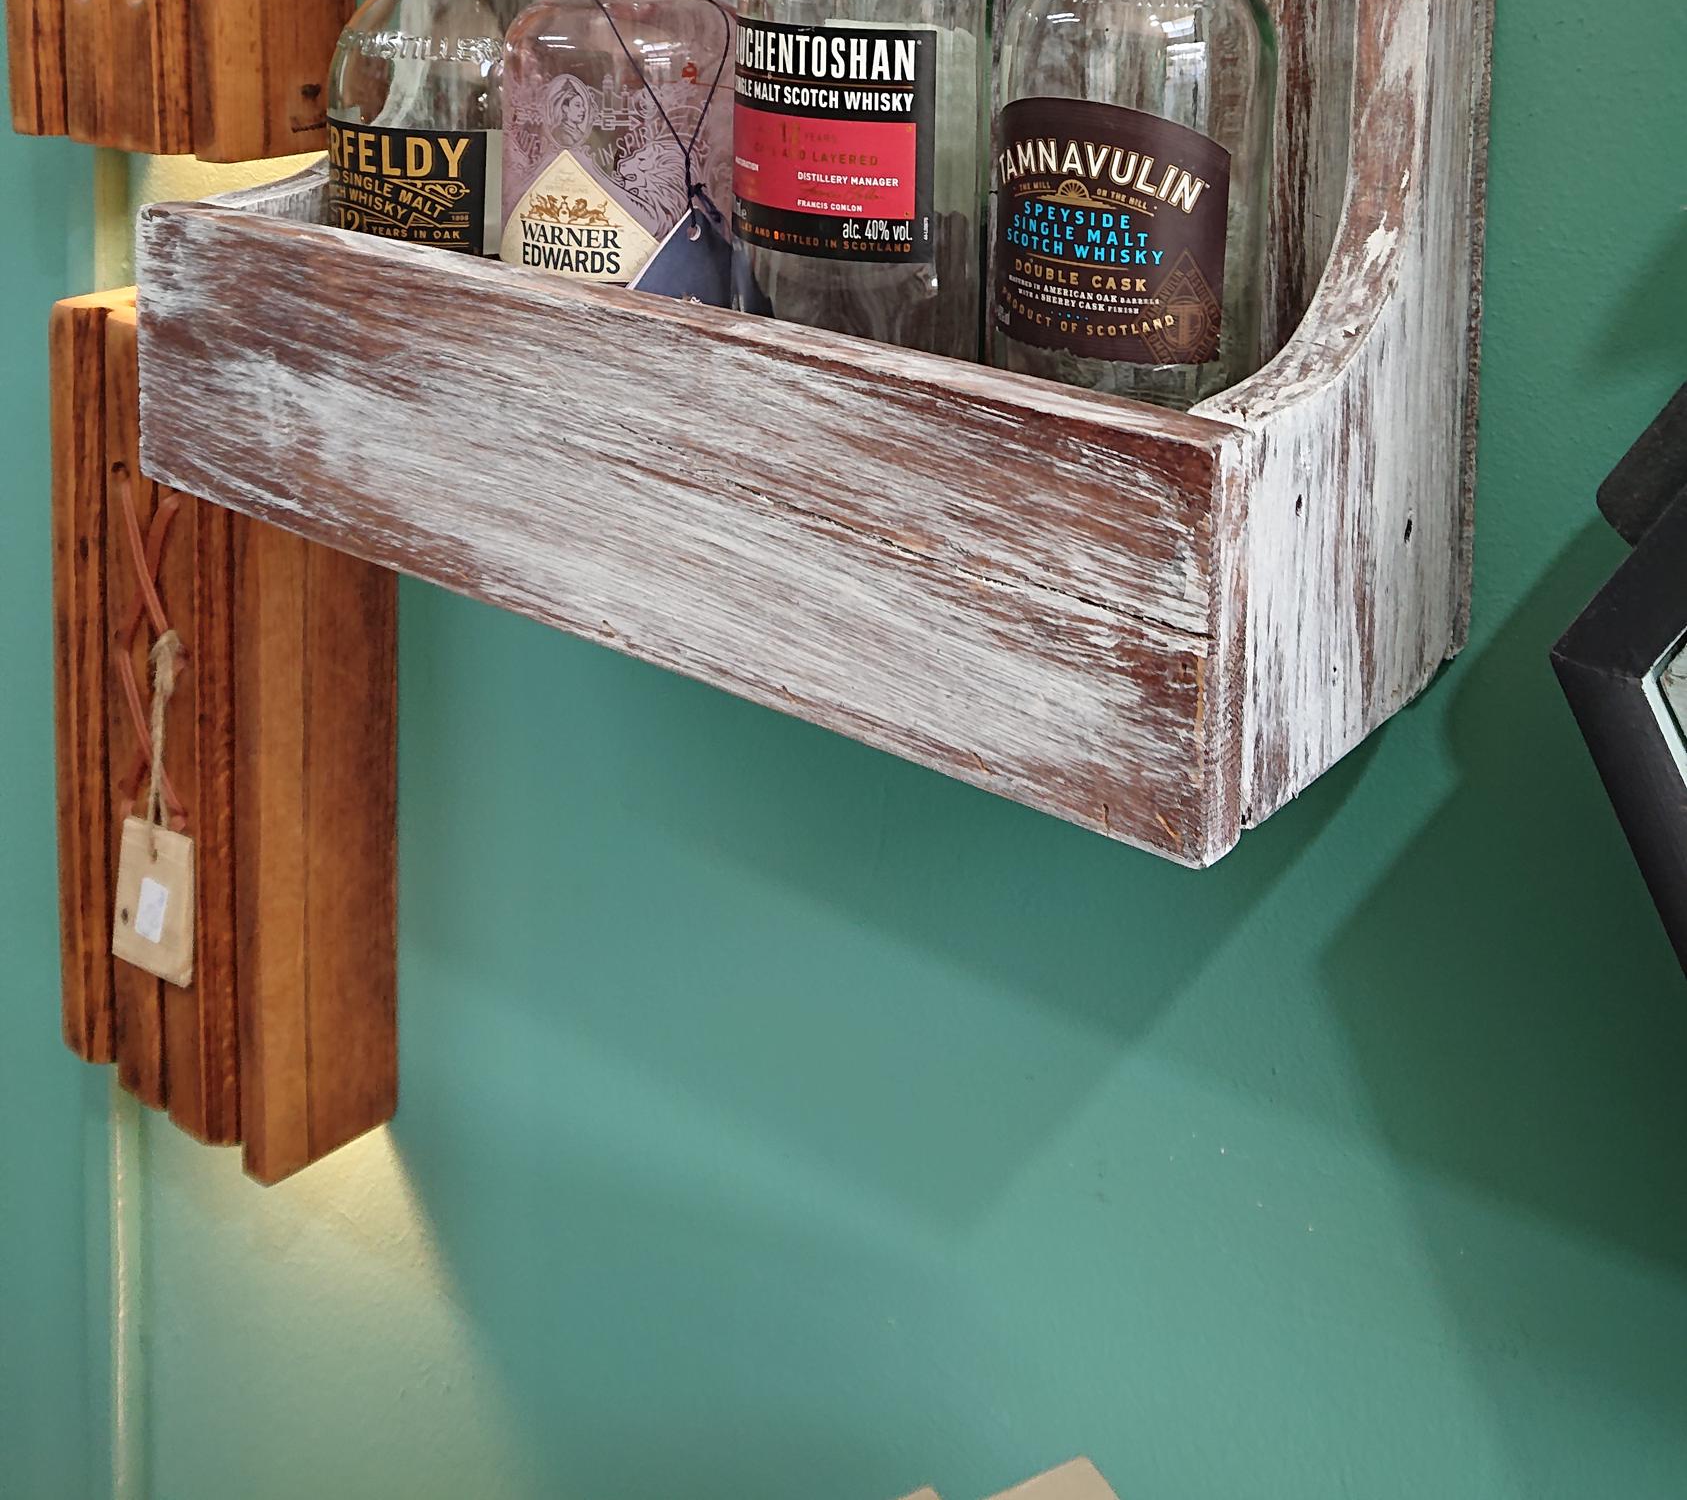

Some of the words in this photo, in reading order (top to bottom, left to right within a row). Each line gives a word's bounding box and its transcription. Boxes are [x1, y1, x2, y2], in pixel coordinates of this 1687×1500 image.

[736, 24, 915, 81] UCHENTOSHAN
[754, 81, 781, 103] MALT
[783, 85, 839, 109] SCOTCH
[844, 90, 914, 112] WHISKY
[330, 125, 470, 179] RFELDY
[812, 150, 878, 166] LAYERED
[797, 171, 848, 185] DISTILLERY
[850, 176, 899, 187] MANAGER
[999, 138, 1205, 214] TAMNAVULIN
[342, 170, 394, 198] SINGLE
[399, 189, 446, 219] MALT
[349, 187, 408, 220] WHISKY
[797, 199, 829, 210] FRANCIS
[1096, 188, 1107, 197] ON
[1111, 191, 1126, 202] THE
[842, 218, 861, 239] alc.
[864, 219, 889, 240] 40%
[892, 218, 913, 240] vol.
[1024, 200, 1131, 229] SPEYSIDE
[372, 226, 408, 238] YEARS
[414, 230, 427, 239] IN
[433, 230, 461, 239] OAK
[520, 220, 622, 249] WARNER
[754, 226, 771, 238] AND
[773, 230, 820, 247] BOTTLED
[825, 237, 837, 249] IN
[843, 241, 911, 253] SCOTLAND
[1014, 214, 1075, 240] SINGLE
[1087, 229, 1148, 248] MALT
[523, 241, 621, 275] EDWARDS
[1007, 228, 1063, 256] SCOTCH
[1074, 243, 1164, 265] WHISKY
[1015, 258, 1079, 285] DOUBLE
[1092, 275, 1147, 292] CASK
[1040, 293, 1077, 308] SHERRY
[1078, 301, 1105, 312] CASK
[1107, 306, 1139, 315] FINISH
[1043, 284, 1093, 300] AMERICAN
[1096, 293, 1118, 303] OAK
[1002, 286, 1052, 328] PRODUCT
[1060, 320, 1078, 333] OF
[1087, 315, 1176, 337] SCOTLAND
